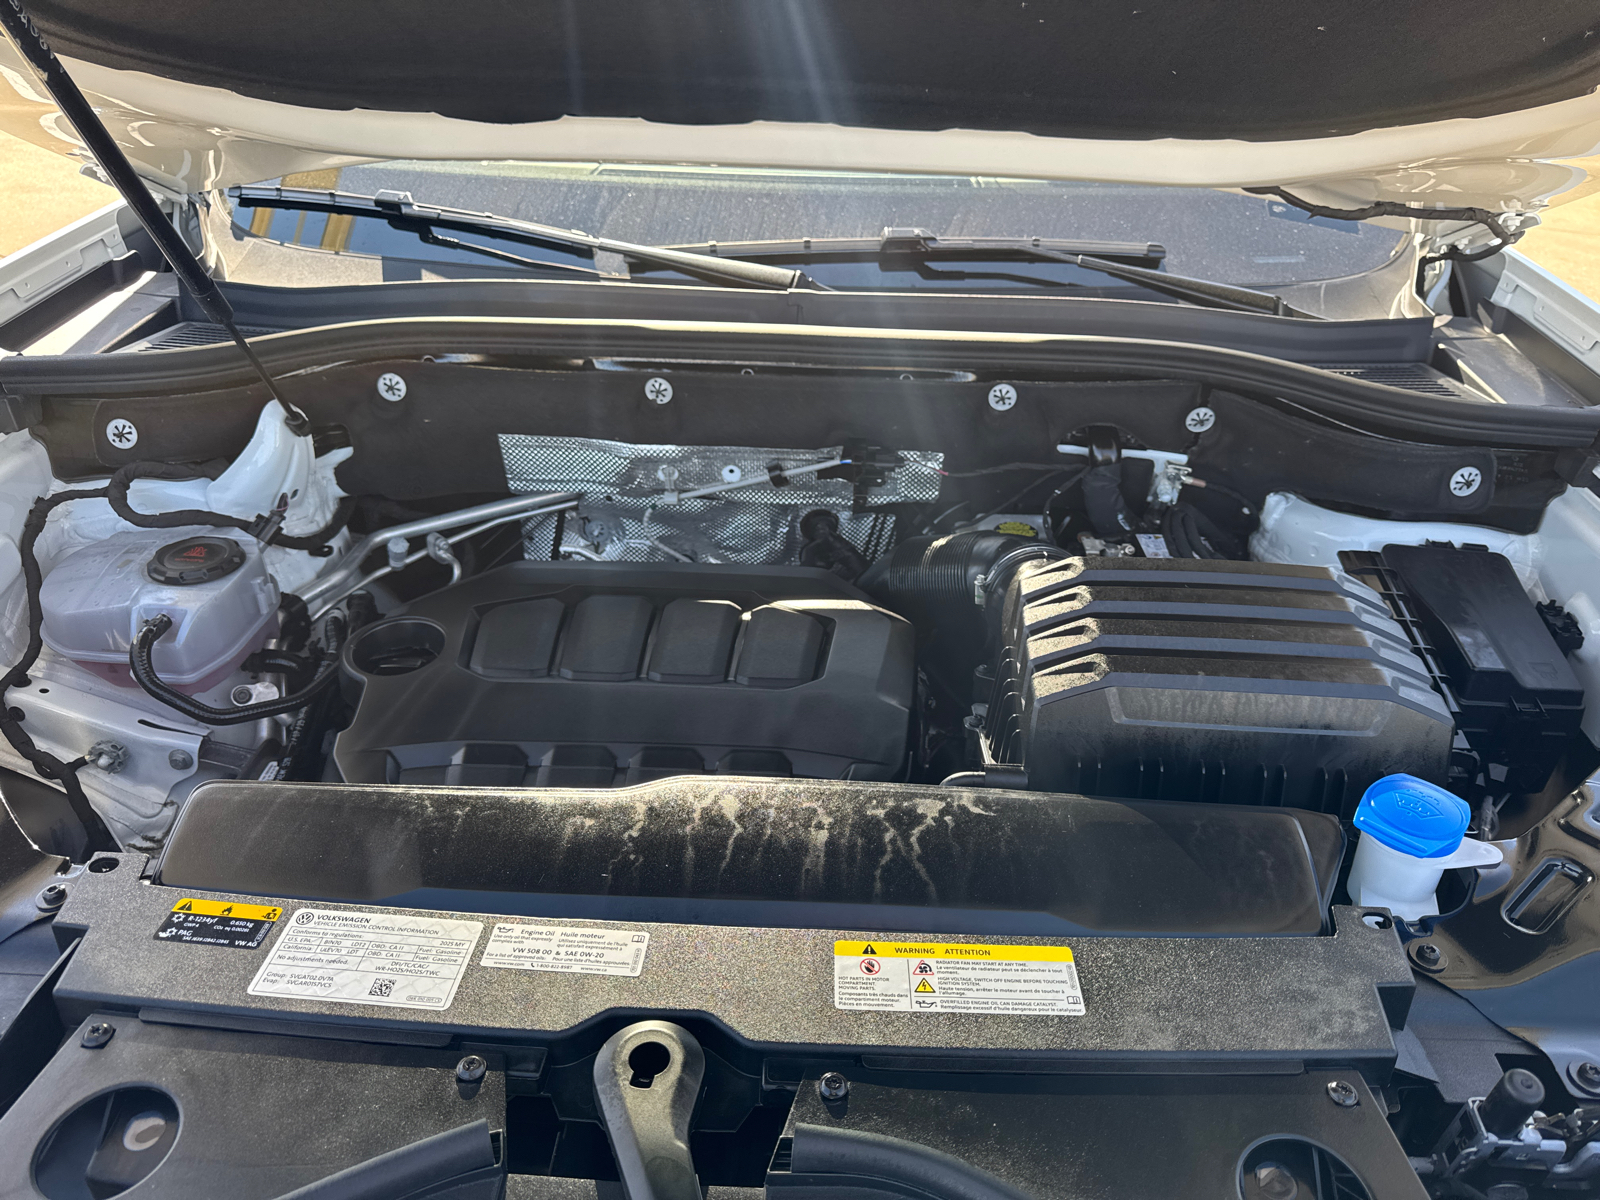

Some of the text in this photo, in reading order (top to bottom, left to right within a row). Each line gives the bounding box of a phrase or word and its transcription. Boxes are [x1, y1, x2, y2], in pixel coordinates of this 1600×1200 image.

[188, 915, 219, 924] R-1234yf
[317, 914, 372, 924] VOLKSWAGEN
[397, 927, 440, 935] INFORMATION
[579, 951, 605, 959] 0W-20
[894, 947, 991, 956] WARNING ATTENTION
[287, 955, 324, 963] adjustments
[390, 961, 430, 969] DFI/TC/CAC/
[266, 971, 287, 979] Group:
[262, 977, 279, 985] Evap:
